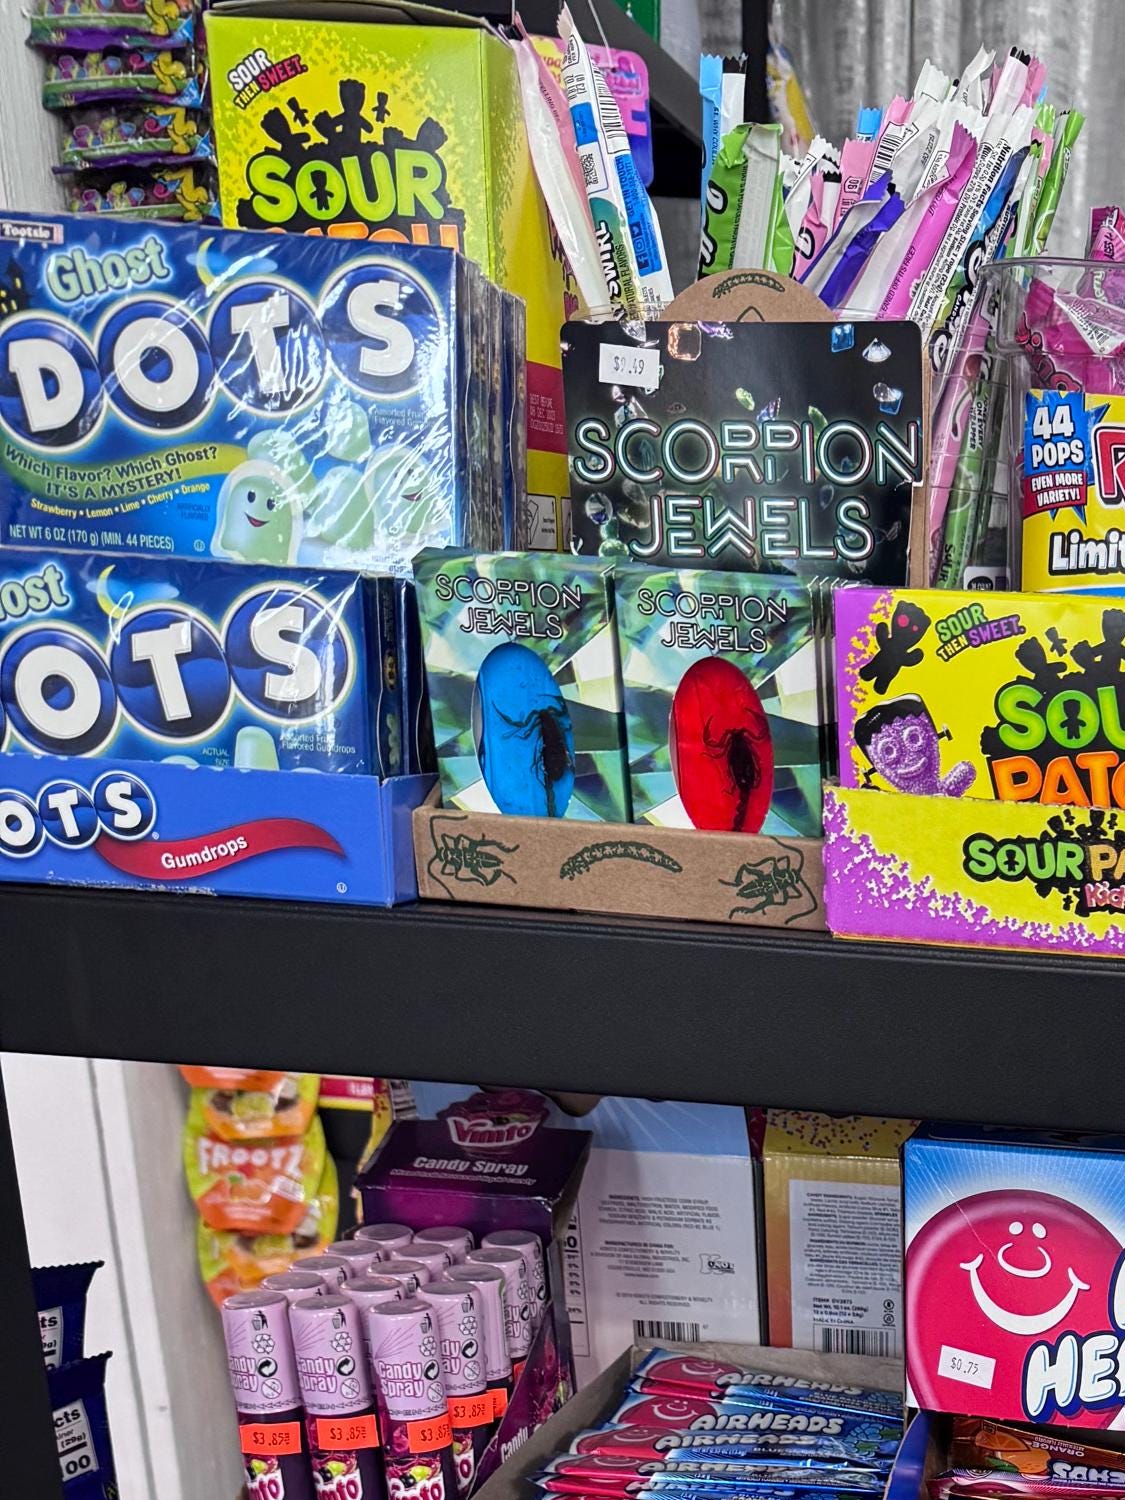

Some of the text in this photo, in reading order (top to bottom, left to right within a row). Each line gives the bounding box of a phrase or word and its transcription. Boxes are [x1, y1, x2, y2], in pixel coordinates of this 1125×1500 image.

[252, 149, 443, 221] SOUR
[2, 225, 51, 240] Tootsie
[47, 238, 169, 300] Ghost
[8, 280, 416, 432] DOTS
[1032, 405, 1075, 439] 44
[6, 444, 218, 482] Which Flavor? Which Ghost?
[575, 418, 924, 486] SCORPION
[1031, 441, 1084, 467] POPS
[30, 481, 210, 519] Strawberry Lemon Lime Cherry Orange
[46, 467, 182, 499] IT'S A MYSTERY!
[1031, 473, 1083, 492] EVEN MORE
[1036, 488, 1081, 507] VARIETY!
[9, 524, 174, 552] NET WT 6 OZ (170 g) (MIN. 44 PIECES)
[630, 496, 874, 561] JEWELS
[435, 574, 581, 611] SCORPION
[460, 607, 562, 640] JEWELS
[937, 604, 987, 642] SOUR
[937, 639, 967, 661] THEN
[161, 835, 247, 870] Gumdrops
[970, 840, 1083, 880] SOUR
[413, 1157, 528, 1176] Candy Spray
